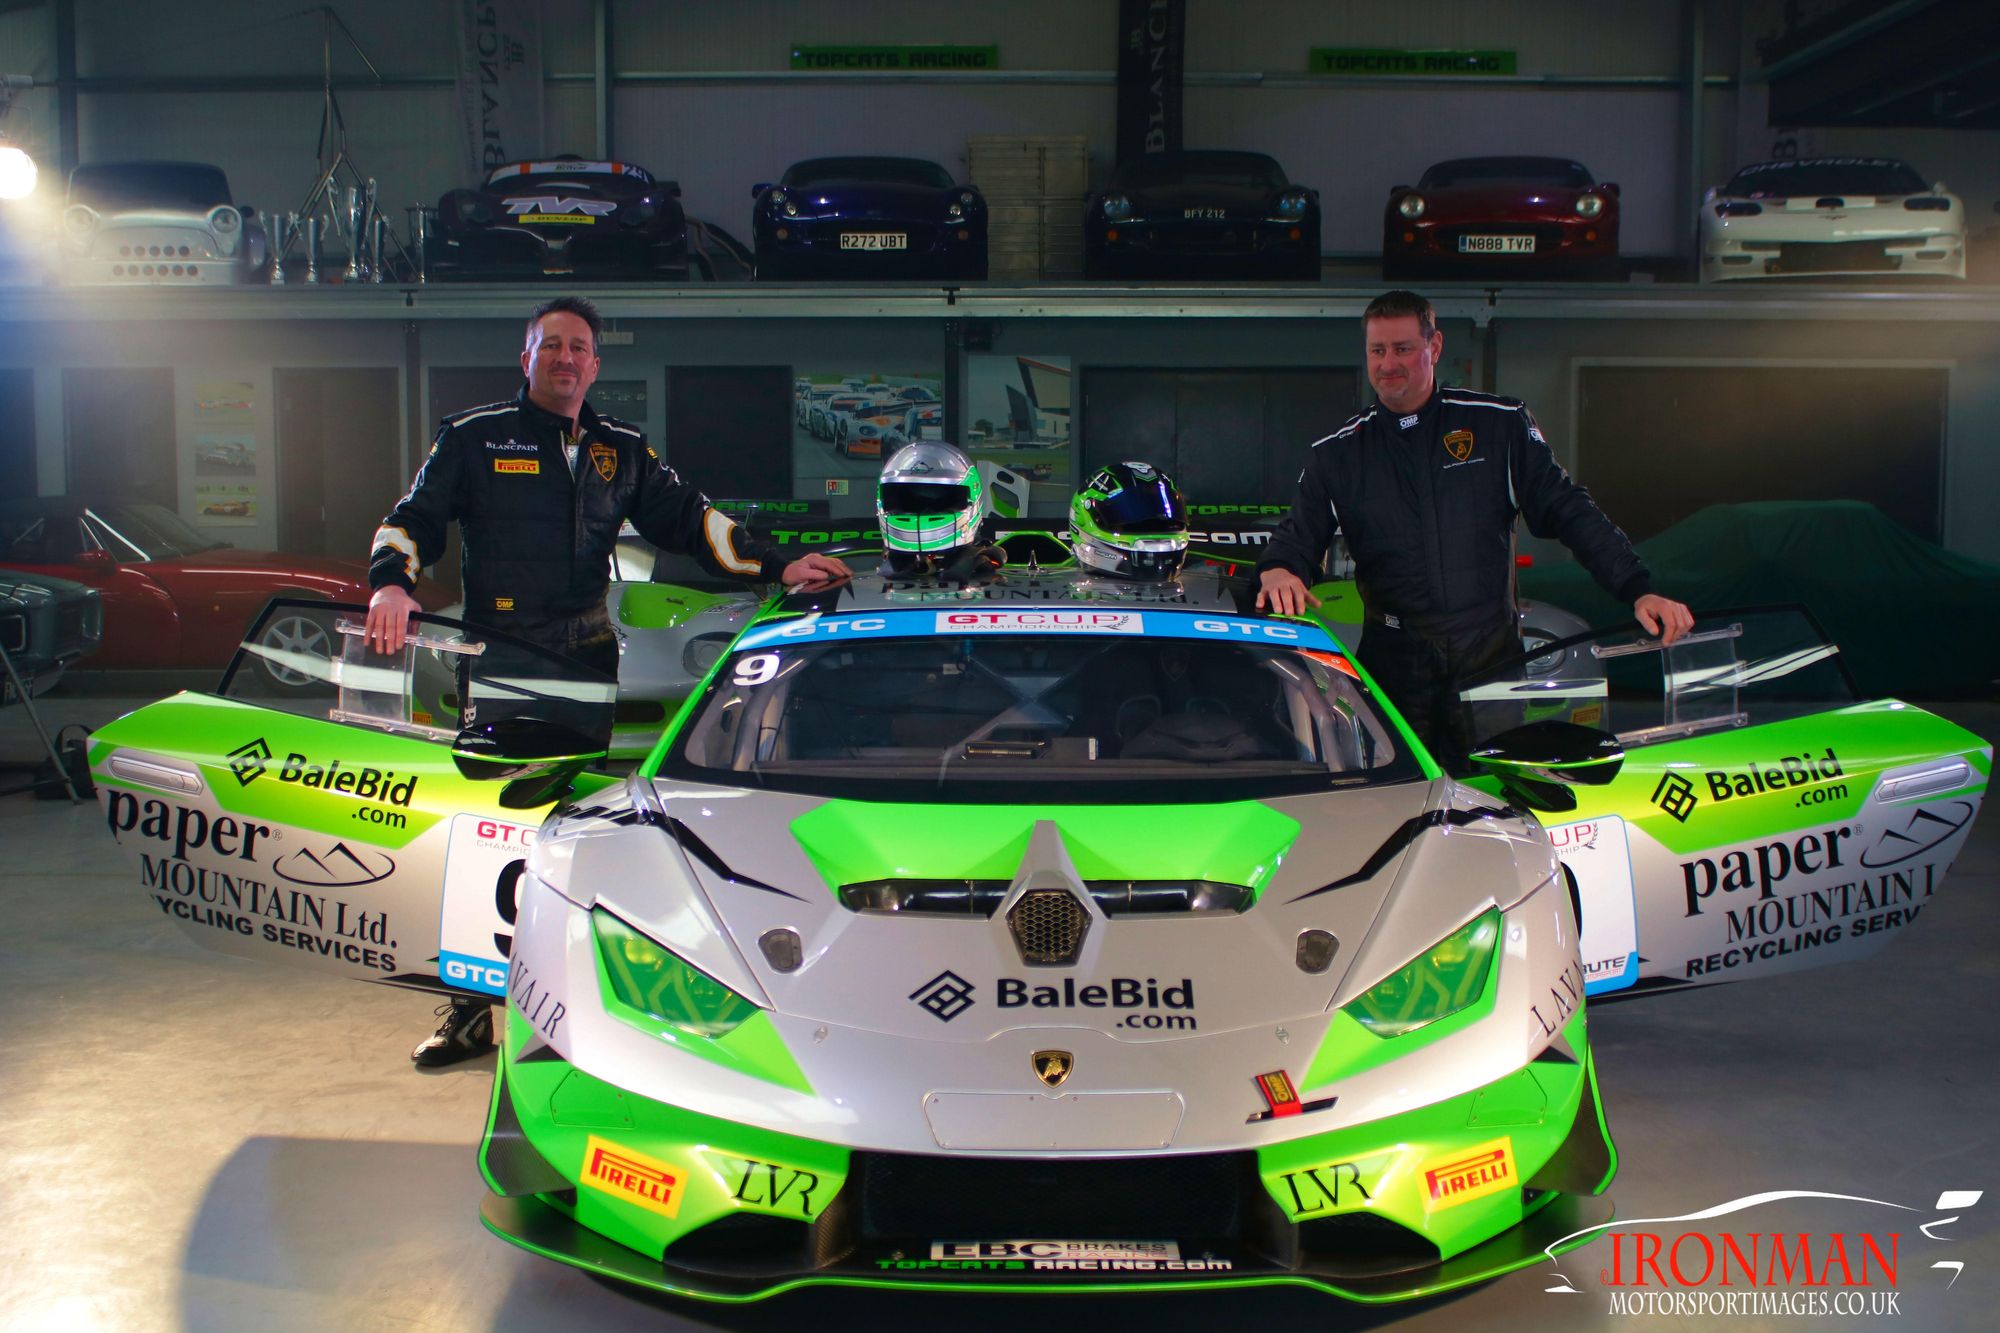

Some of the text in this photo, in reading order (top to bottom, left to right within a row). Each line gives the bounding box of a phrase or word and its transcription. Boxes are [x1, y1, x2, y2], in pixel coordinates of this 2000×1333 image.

[802, 52, 987, 67] TOPCATS RACING
[1324, 55, 1500, 71] TOPCATS RACING
[1145, 0, 1168, 153] BLANC
[842, 235, 905, 247] R272 UBT
[1468, 238, 1533, 250] N888 TVR
[1400, 416, 1419, 428] OMP
[1187, 504, 1293, 516] TOPCAT
[496, 599, 514, 610] OMP
[781, 618, 886, 637] GTC
[1193, 620, 1299, 639] GTC
[733, 654, 780, 686] 9
[279, 753, 418, 807] BaleBid
[1705, 748, 1845, 801] BaleBid
[1795, 784, 1849, 808] .com
[351, 806, 407, 829] .com
[1550, 825, 1592, 846] UP
[140, 853, 398, 948] MOUNTAIN Ltd.
[1726, 868, 1914, 945] MOUNTAIN
[150, 894, 253, 937] YCLING
[262, 923, 397, 973] SERVICES
[1686, 903, 1927, 977] RECYCLING SERV
[446, 960, 506, 988] GTC
[997, 978, 1195, 1010] BaleBid
[1116, 1014, 1197, 1030] .com
[590, 1147, 677, 1206] PIRELLI
[1425, 1149, 1508, 1201] PIRELLI
[731, 1159, 819, 1216] LVR
[1279, 1161, 1376, 1216] LVR
[942, 1243, 1063, 1259] EBC
[1067, 1243, 1167, 1251] BRAKES
[875, 1259, 1232, 1270] TOPCATS RACING.com
